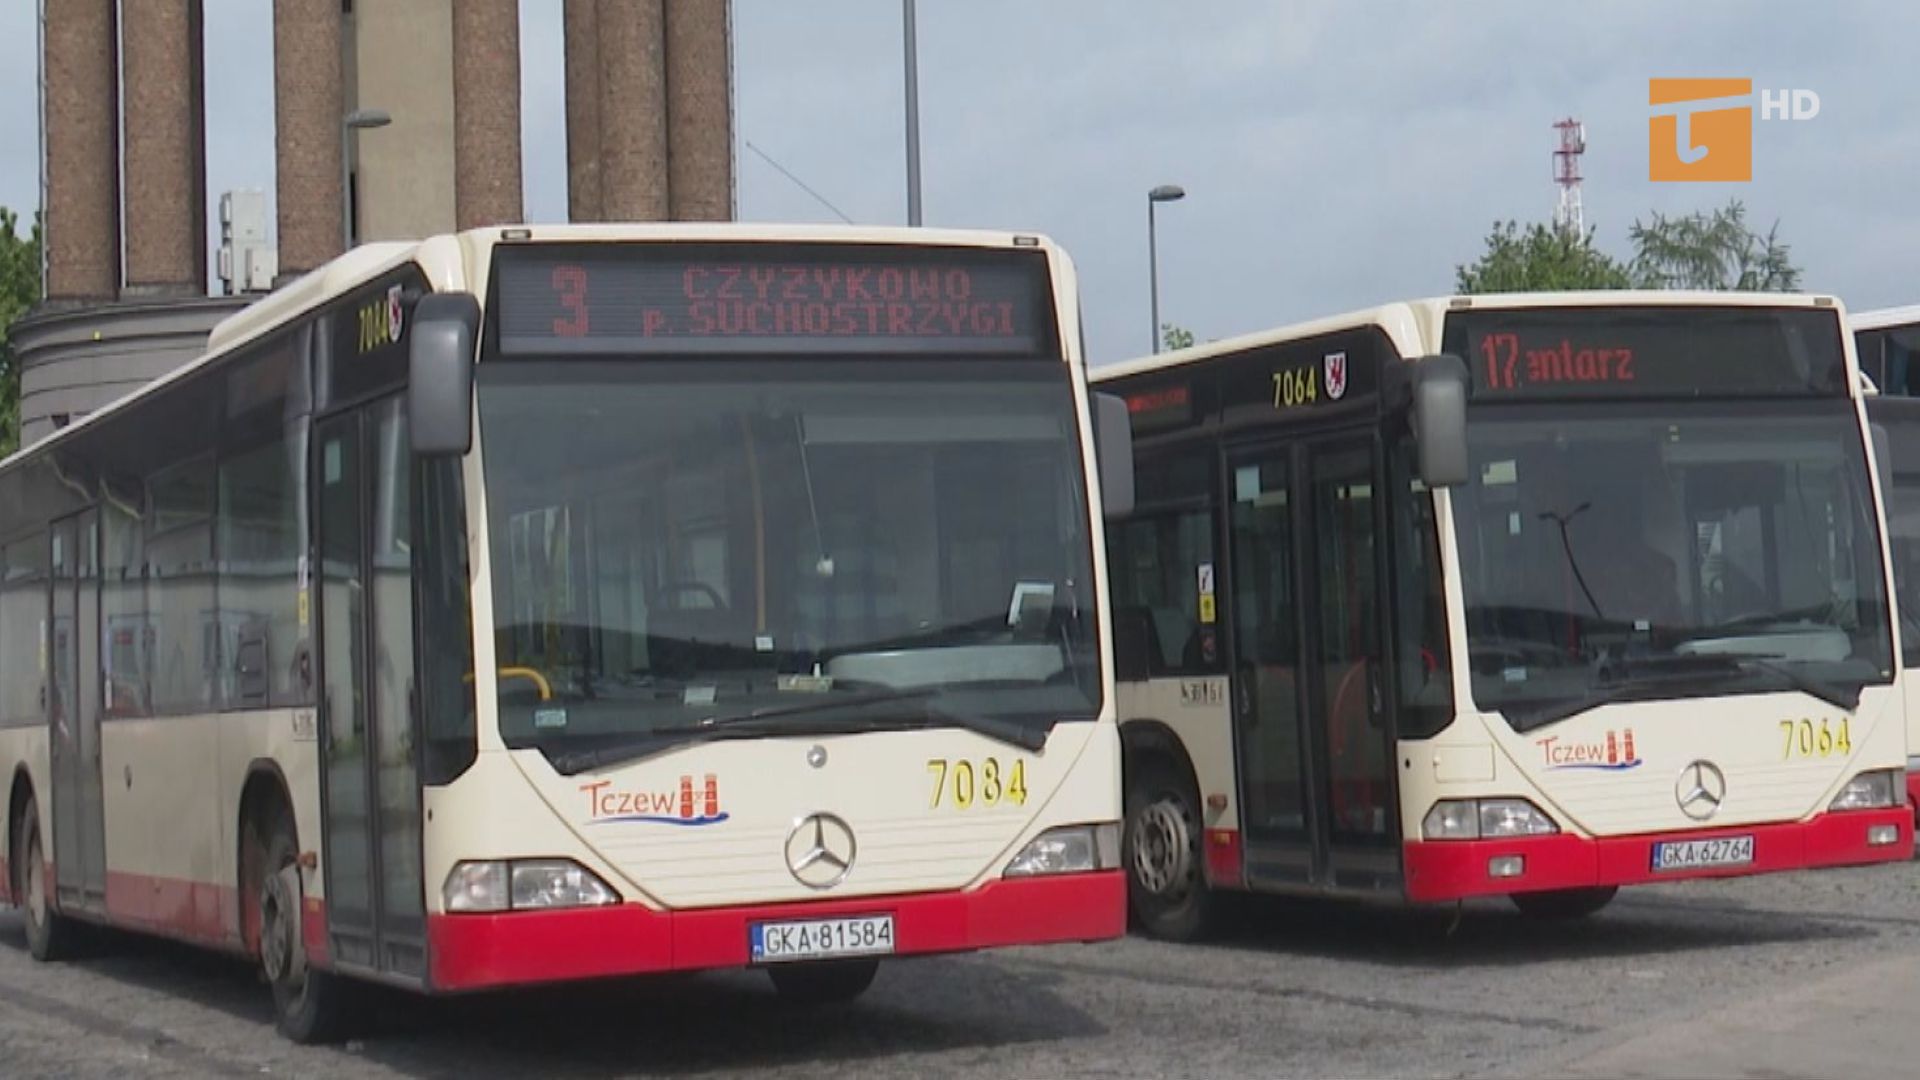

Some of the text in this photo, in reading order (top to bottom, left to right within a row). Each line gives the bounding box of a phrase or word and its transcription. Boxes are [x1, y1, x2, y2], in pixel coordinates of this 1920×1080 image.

[551, 265, 972, 338] 3 CZYZYKOWO
[688, 302, 1015, 337] SUCHOSTRZYGI
[1481, 332, 1519, 389] 17
[1273, 365, 1316, 409] 7064
[1535, 735, 1605, 765] Tczew
[1779, 717, 1852, 760] 7064
[578, 780, 676, 818] Tczew
[926, 757, 1028, 811] 7084
